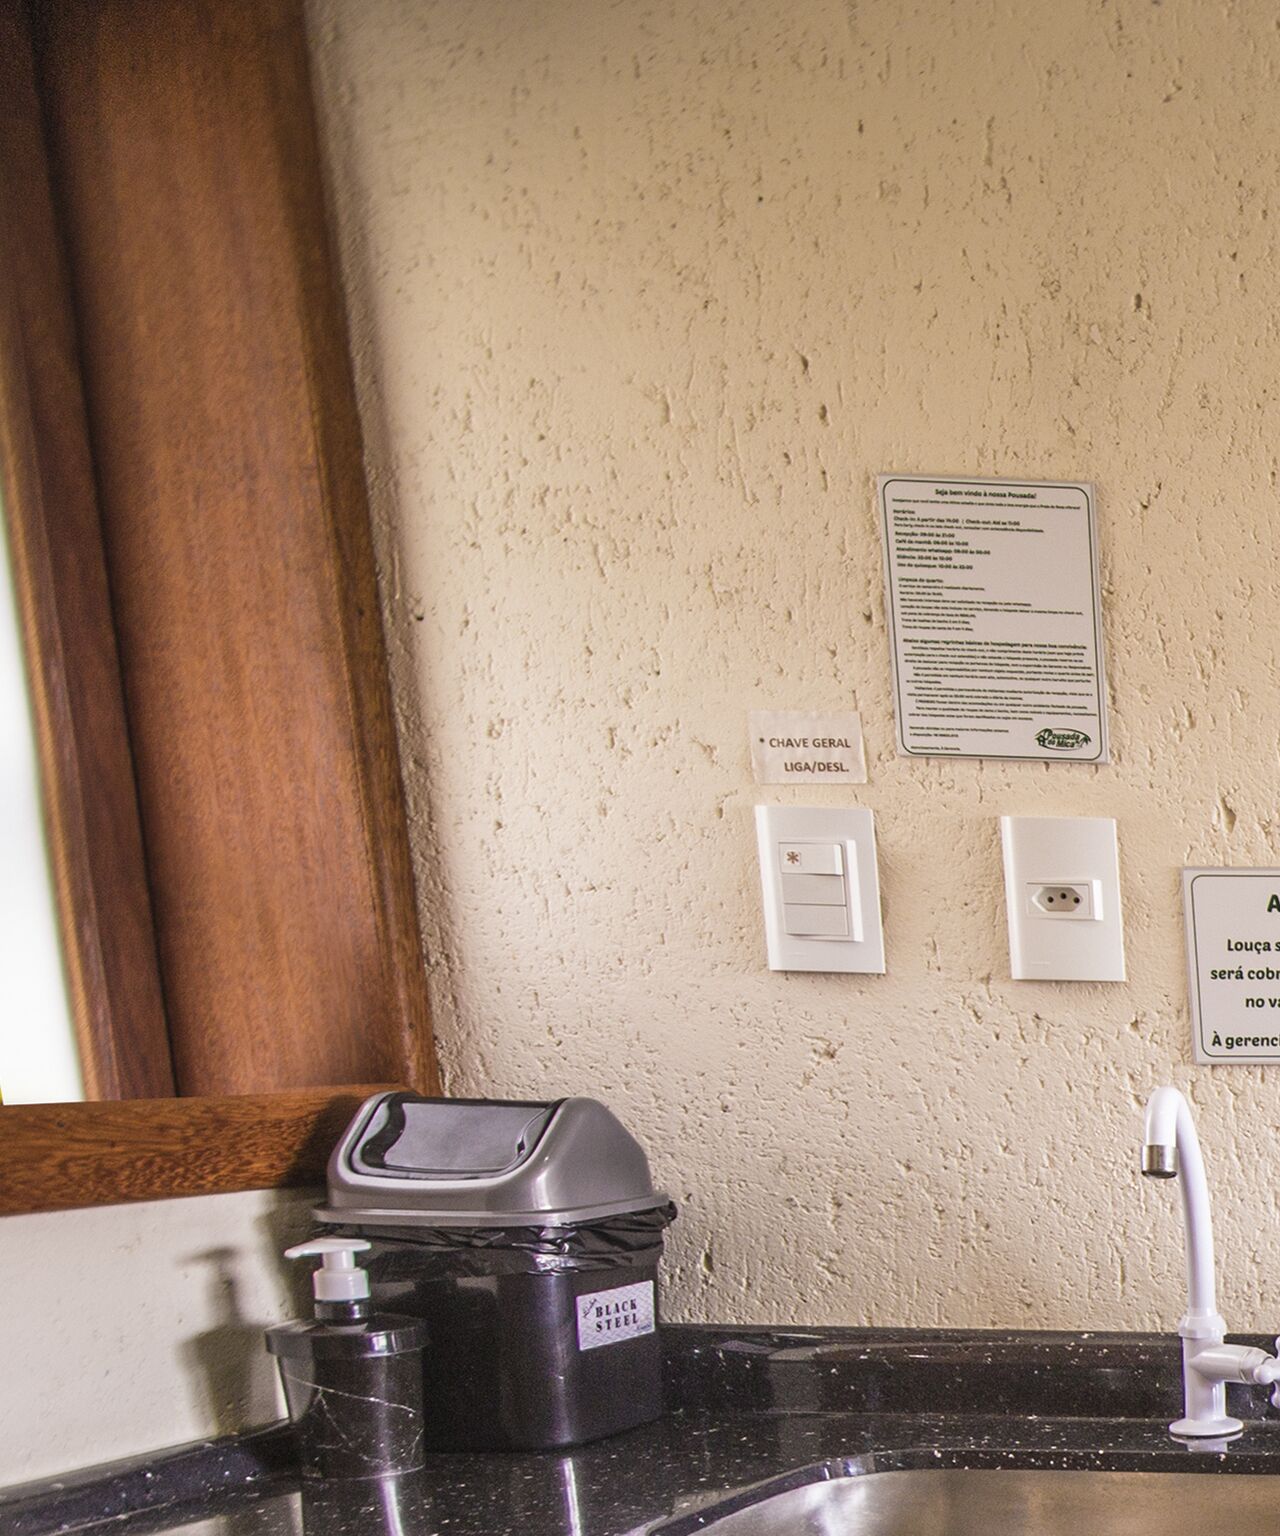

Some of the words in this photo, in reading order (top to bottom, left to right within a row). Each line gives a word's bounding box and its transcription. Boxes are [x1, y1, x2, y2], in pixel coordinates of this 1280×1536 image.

[1008, 491, 1037, 499] Pousada!
[769, 738, 809, 748] CHAVE
[812, 738, 851, 748] GERAL
[784, 761, 849, 773] LIGA/DESL.
[1227, 939, 1272, 954] Louça
[1210, 966, 1244, 980] será
[1245, 996, 1265, 1008] no
[1211, 1031, 1222, 1047] À
[595, 1298, 637, 1318] BLACK
[596, 1313, 639, 1333] STEEL
